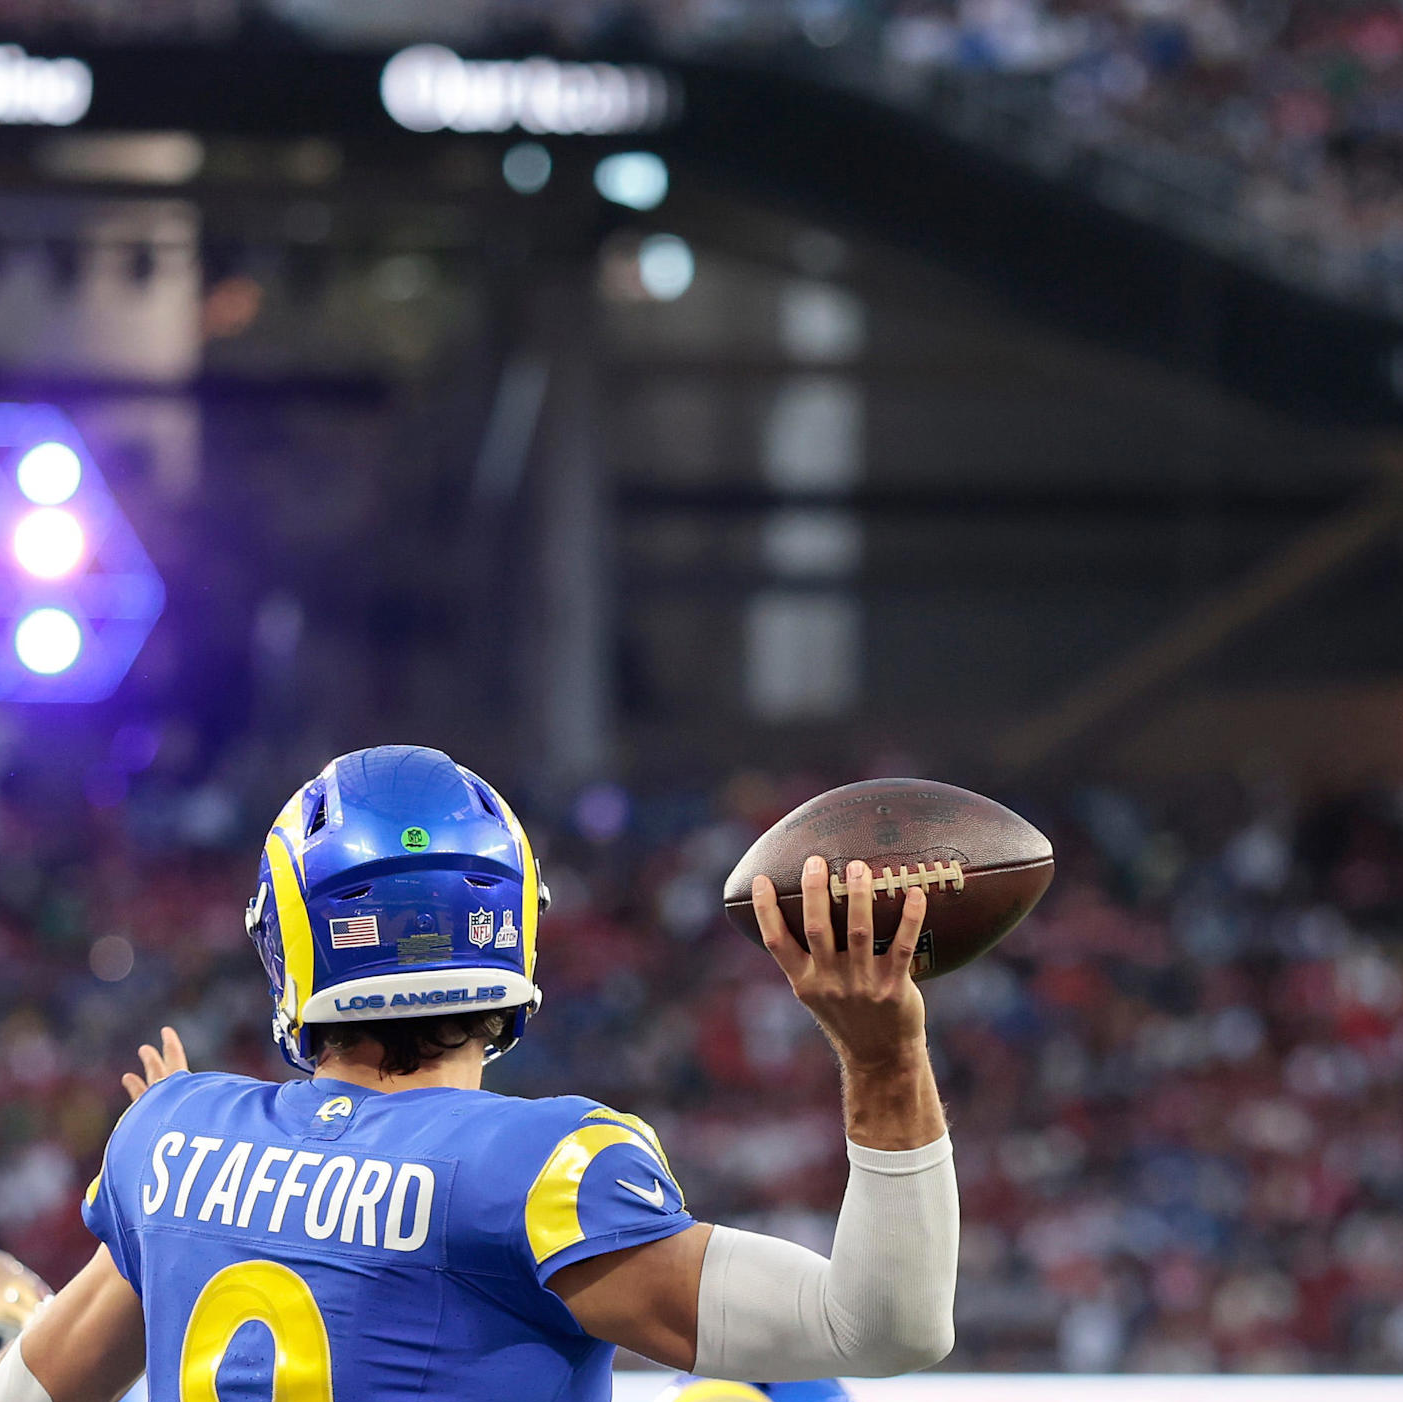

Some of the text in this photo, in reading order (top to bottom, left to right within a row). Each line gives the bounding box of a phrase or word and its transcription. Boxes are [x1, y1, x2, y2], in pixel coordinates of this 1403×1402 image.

[334, 985, 507, 1012] LOS ANGELES
[142, 1131, 436, 1253] STAFFORD
